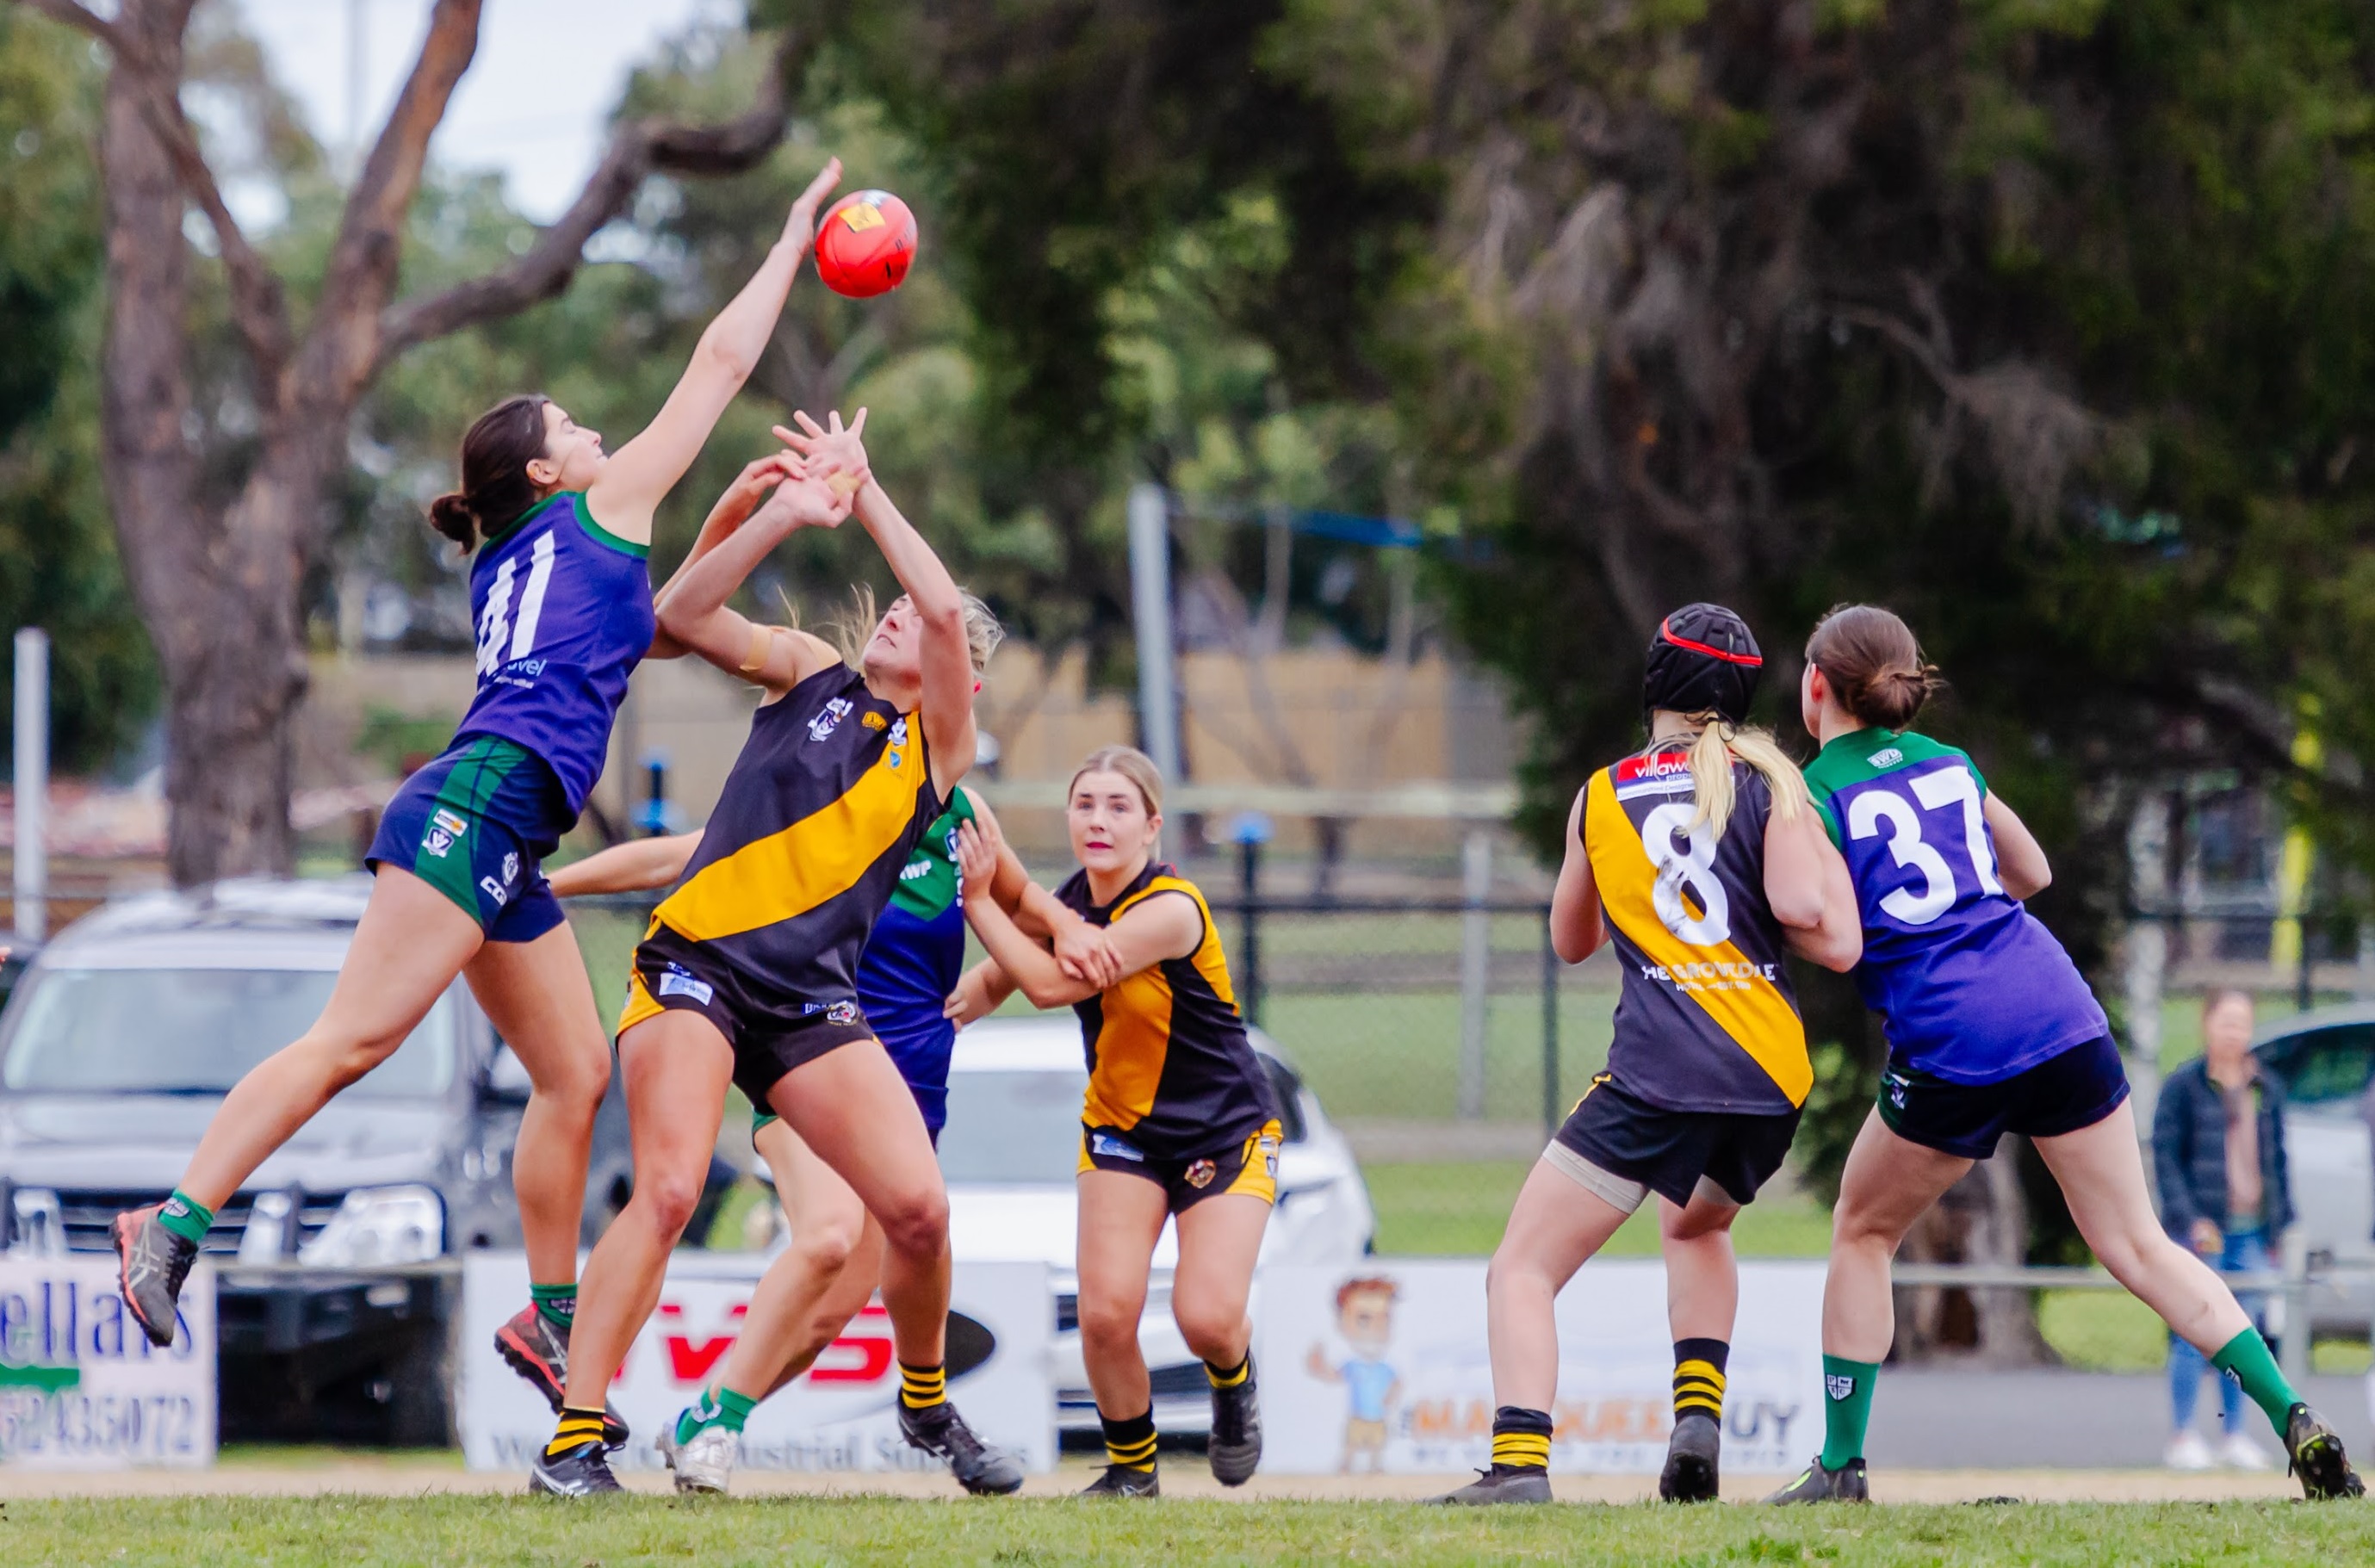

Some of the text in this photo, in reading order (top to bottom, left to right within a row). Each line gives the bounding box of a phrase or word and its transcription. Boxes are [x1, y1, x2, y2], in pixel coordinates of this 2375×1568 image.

[1641, 803, 1732, 947] 8
[1847, 765, 2004, 926] 37
[0, 1281, 192, 1358] ellas
[1725, 1400, 1801, 1441] UY
